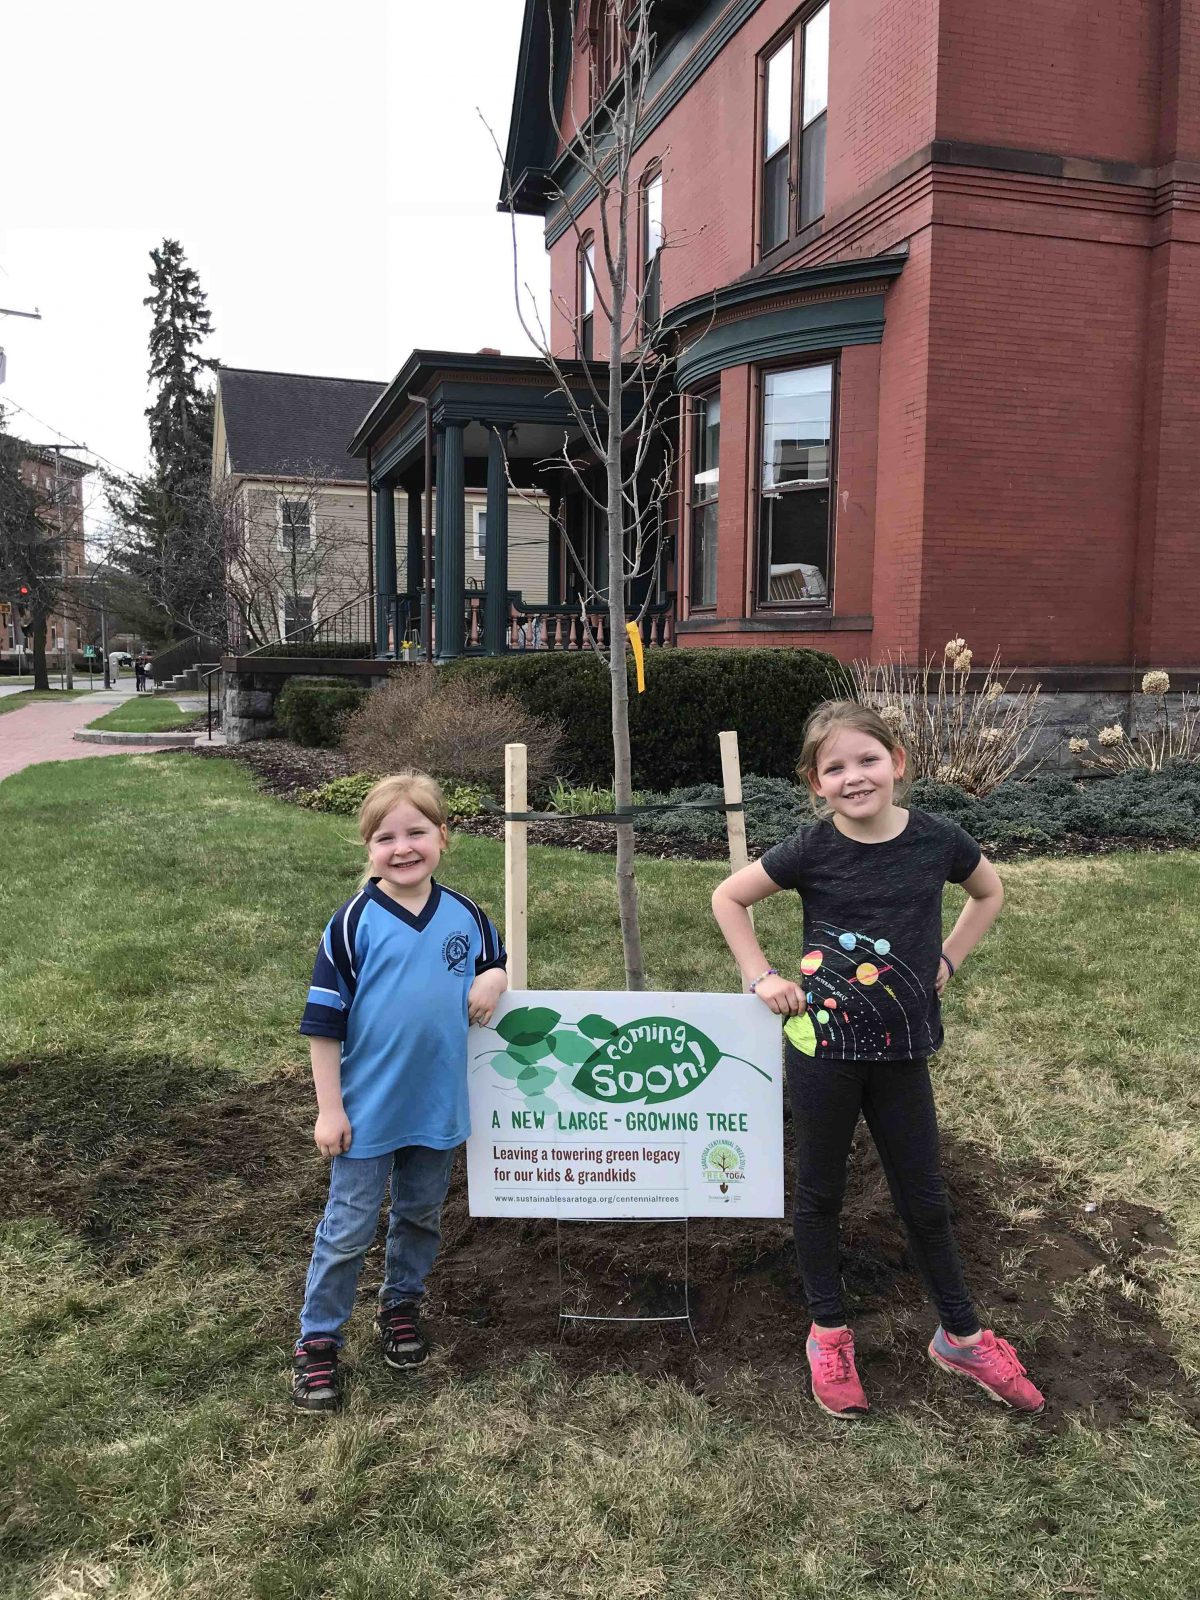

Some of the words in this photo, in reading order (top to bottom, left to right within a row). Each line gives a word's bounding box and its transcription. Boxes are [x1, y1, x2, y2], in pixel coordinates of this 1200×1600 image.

[606, 1023, 686, 1060] coming
[491, 1110, 501, 1129] A
[511, 1110, 545, 1130] NEW
[706, 1112, 749, 1133] TREE
[493, 1145, 539, 1164] Leaving
[541, 1149, 548, 1161] a
[550, 1147, 603, 1164] towering
[605, 1149, 639, 1164] green
[642, 1147, 681, 1165] legacy
[494, 1167, 511, 1182] for
[514, 1170, 534, 1182] our
[536, 1168, 561, 1183] kids
[564, 1168, 575, 1183] &
[578, 1168, 636, 1185] grandkids
[494, 1194, 679, 1204] www.sustainablesaratoga.org/centennialtrees
